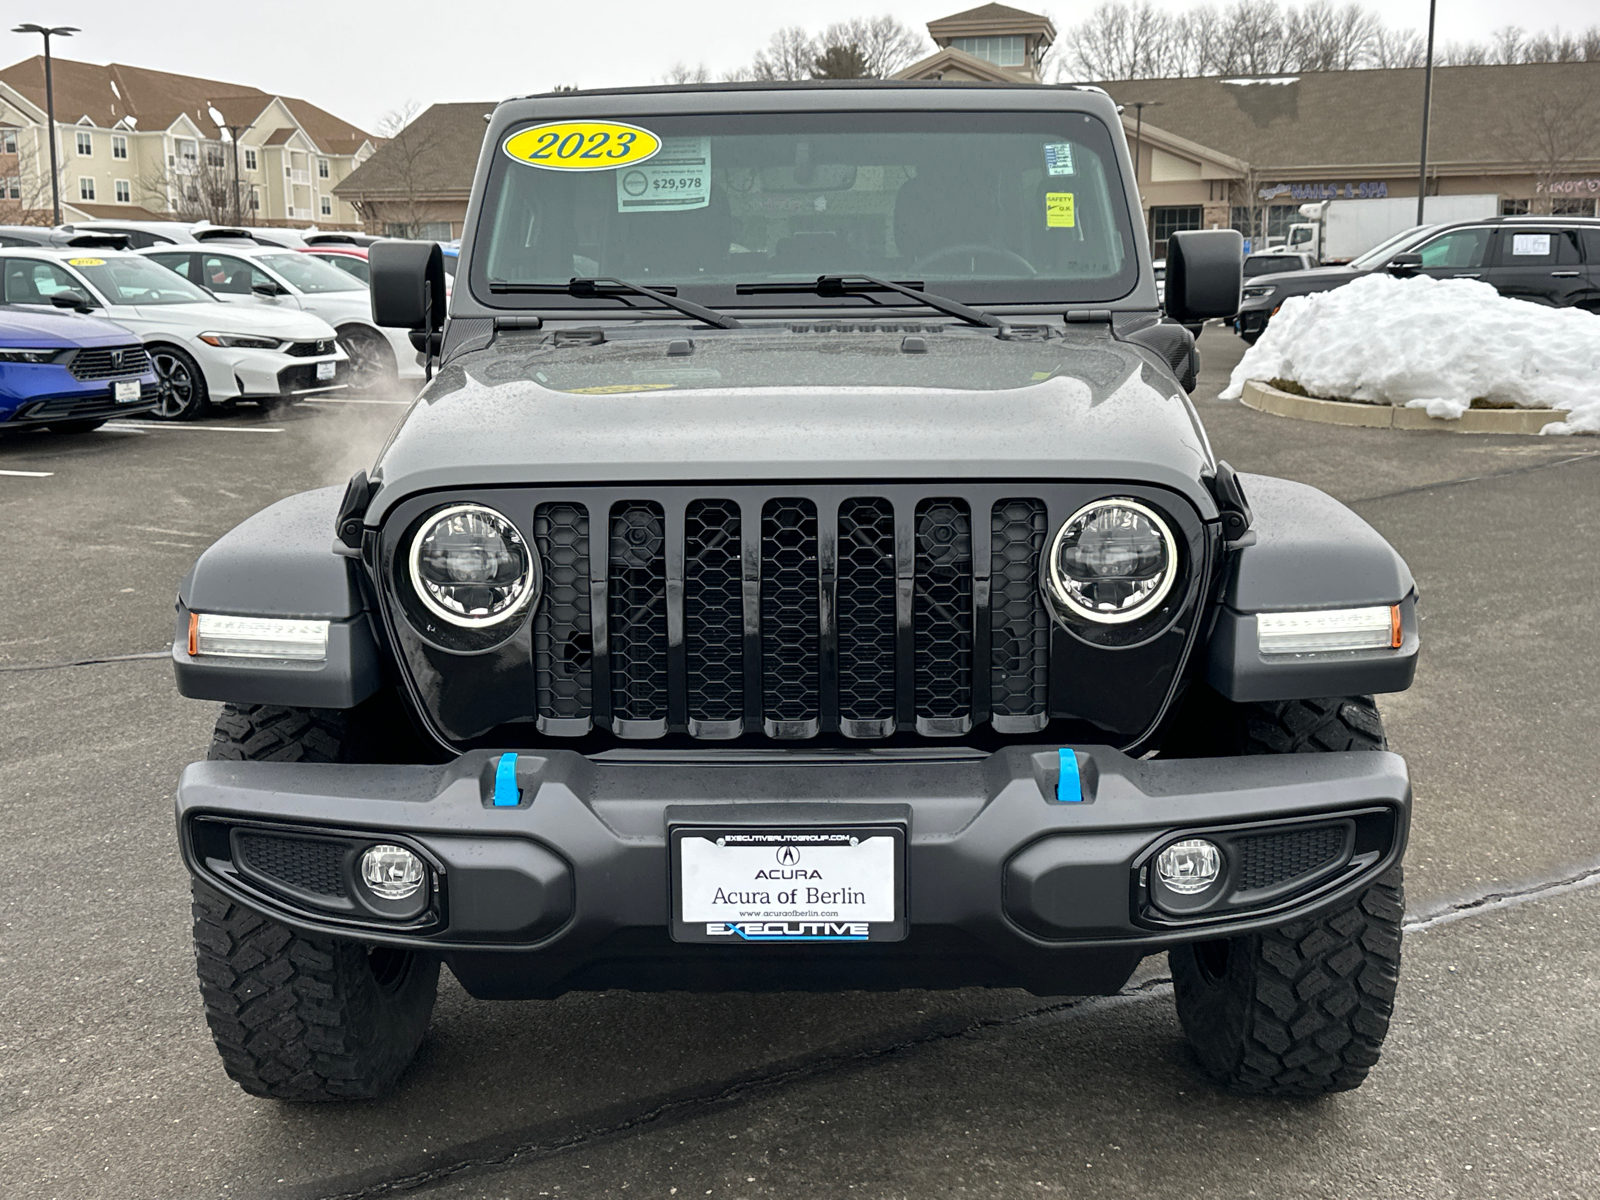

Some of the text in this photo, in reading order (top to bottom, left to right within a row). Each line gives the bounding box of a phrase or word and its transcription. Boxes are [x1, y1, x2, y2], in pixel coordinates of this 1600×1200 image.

[528, 132, 637, 159] 2023
[653, 178, 702, 191] $29,978
[1291, 184, 1338, 199] NAILS
[1344, 183, 1354, 197] &
[1359, 182, 1388, 198] SPA
[725, 834, 850, 842] EXECUTIVEAUTOGROUP.COM
[754, 869, 823, 880] ACURA
[711, 887, 866, 905] Acura of Berlin
[739, 909, 839, 918] www.acuraofberlin.com
[706, 922, 869, 938] EXECUTIVE
